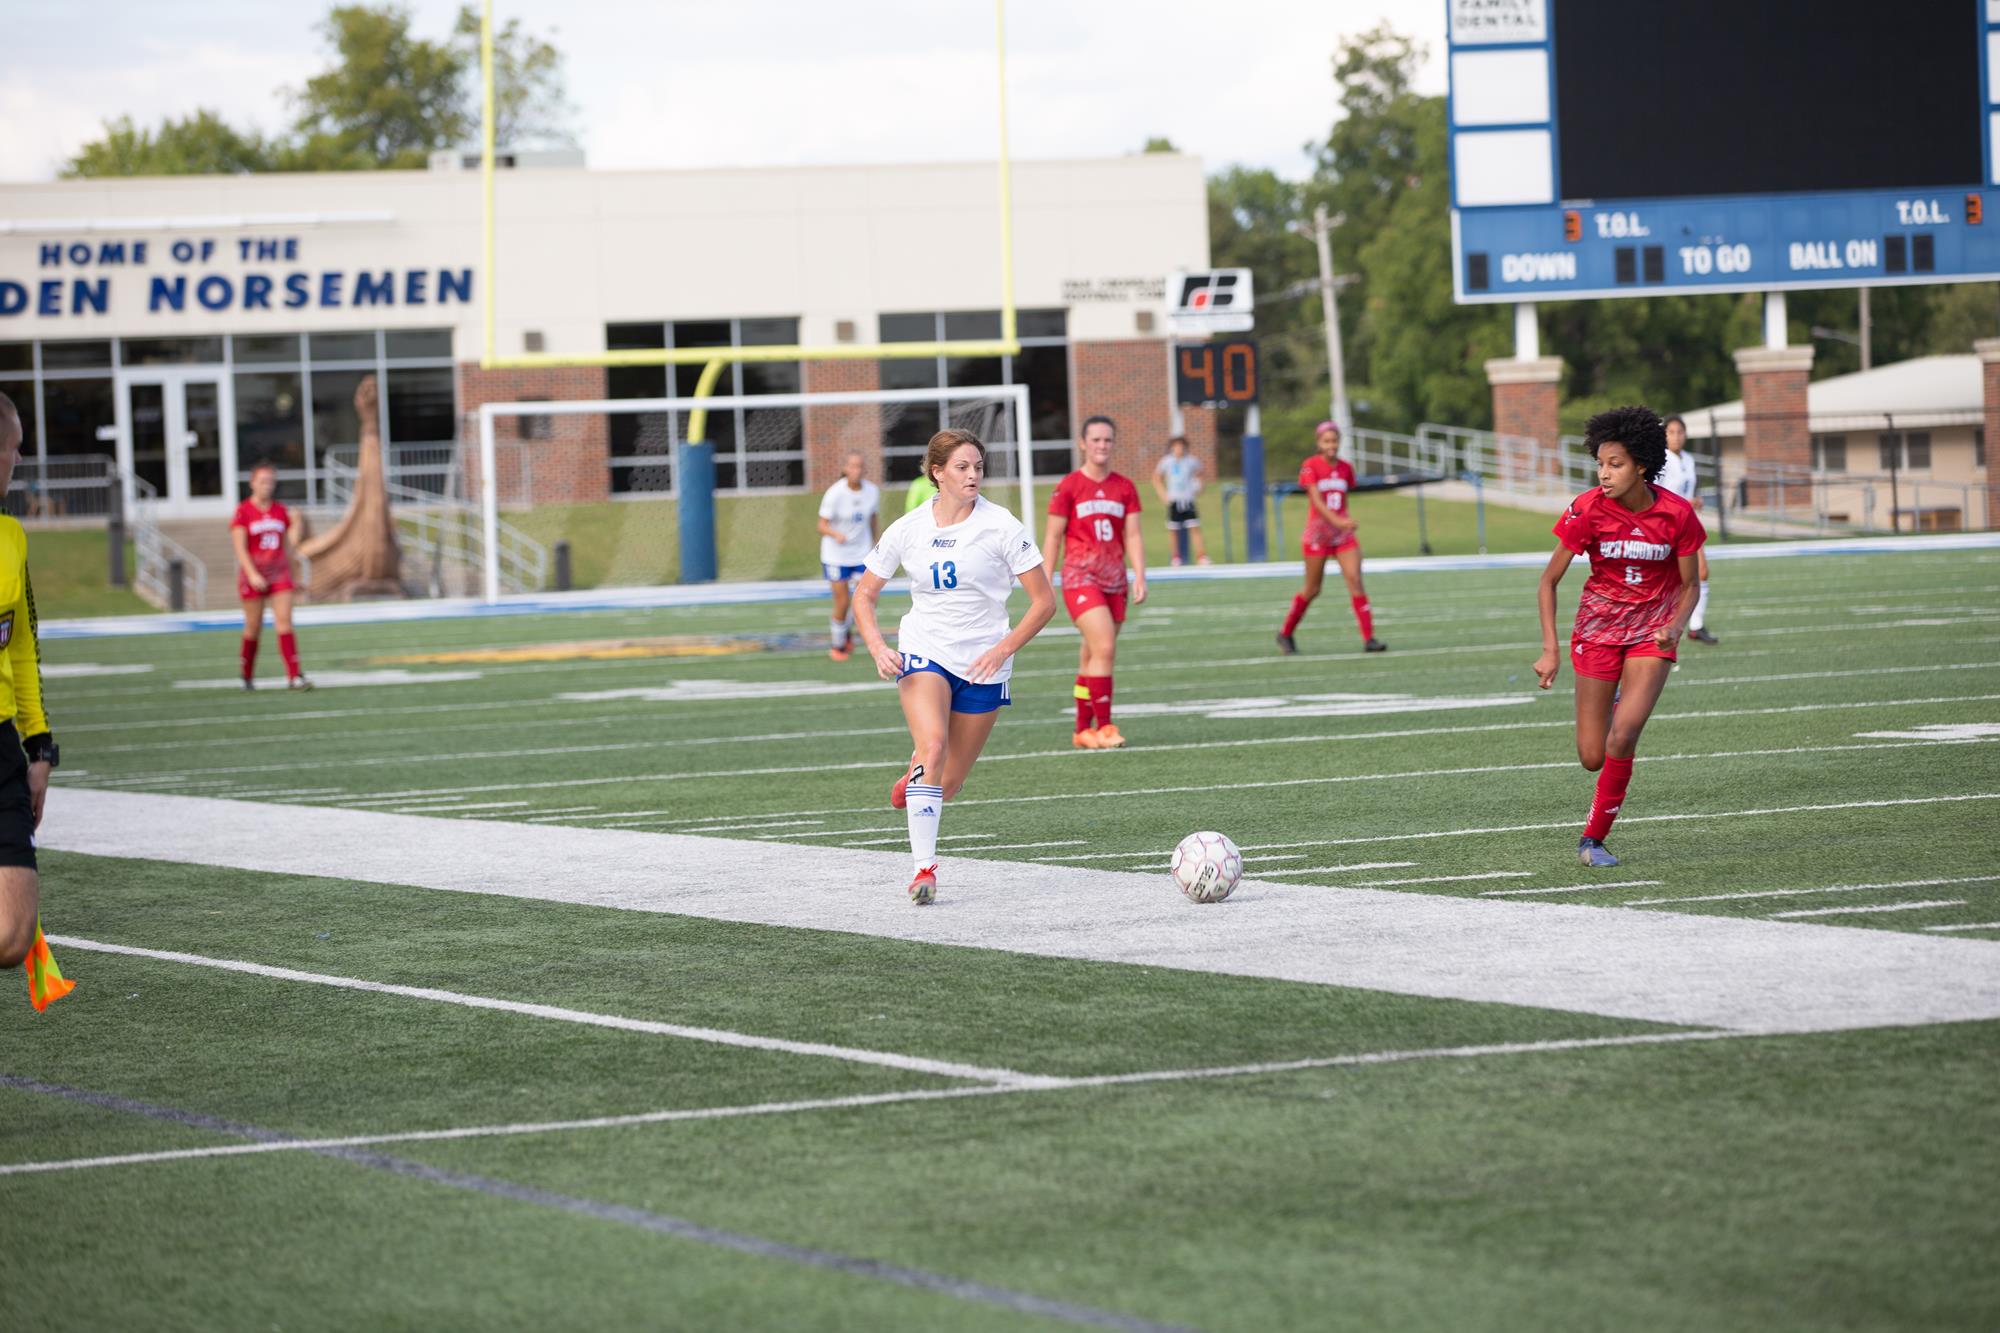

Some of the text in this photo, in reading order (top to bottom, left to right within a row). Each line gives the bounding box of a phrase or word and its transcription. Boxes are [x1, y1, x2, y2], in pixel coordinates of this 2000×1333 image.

[1457, 15, 1535, 28] DENTAL
[1896, 200, 1950, 225] T.O.L.
[1966, 193, 1982, 224] 3
[1564, 210, 1582, 241] 3
[1595, 212, 1650, 237] T.O.L.
[40, 238, 300, 268] HOME OF THE
[1502, 252, 1577, 282] DOWN
[1680, 243, 1751, 275] TO GO
[1789, 239, 1877, 270] BALL ON
[149, 269, 473, 313] NORSEMEN
[1181, 344, 1255, 400] 40
[931, 539, 957, 548] NEO
[929, 560, 958, 590] 13
